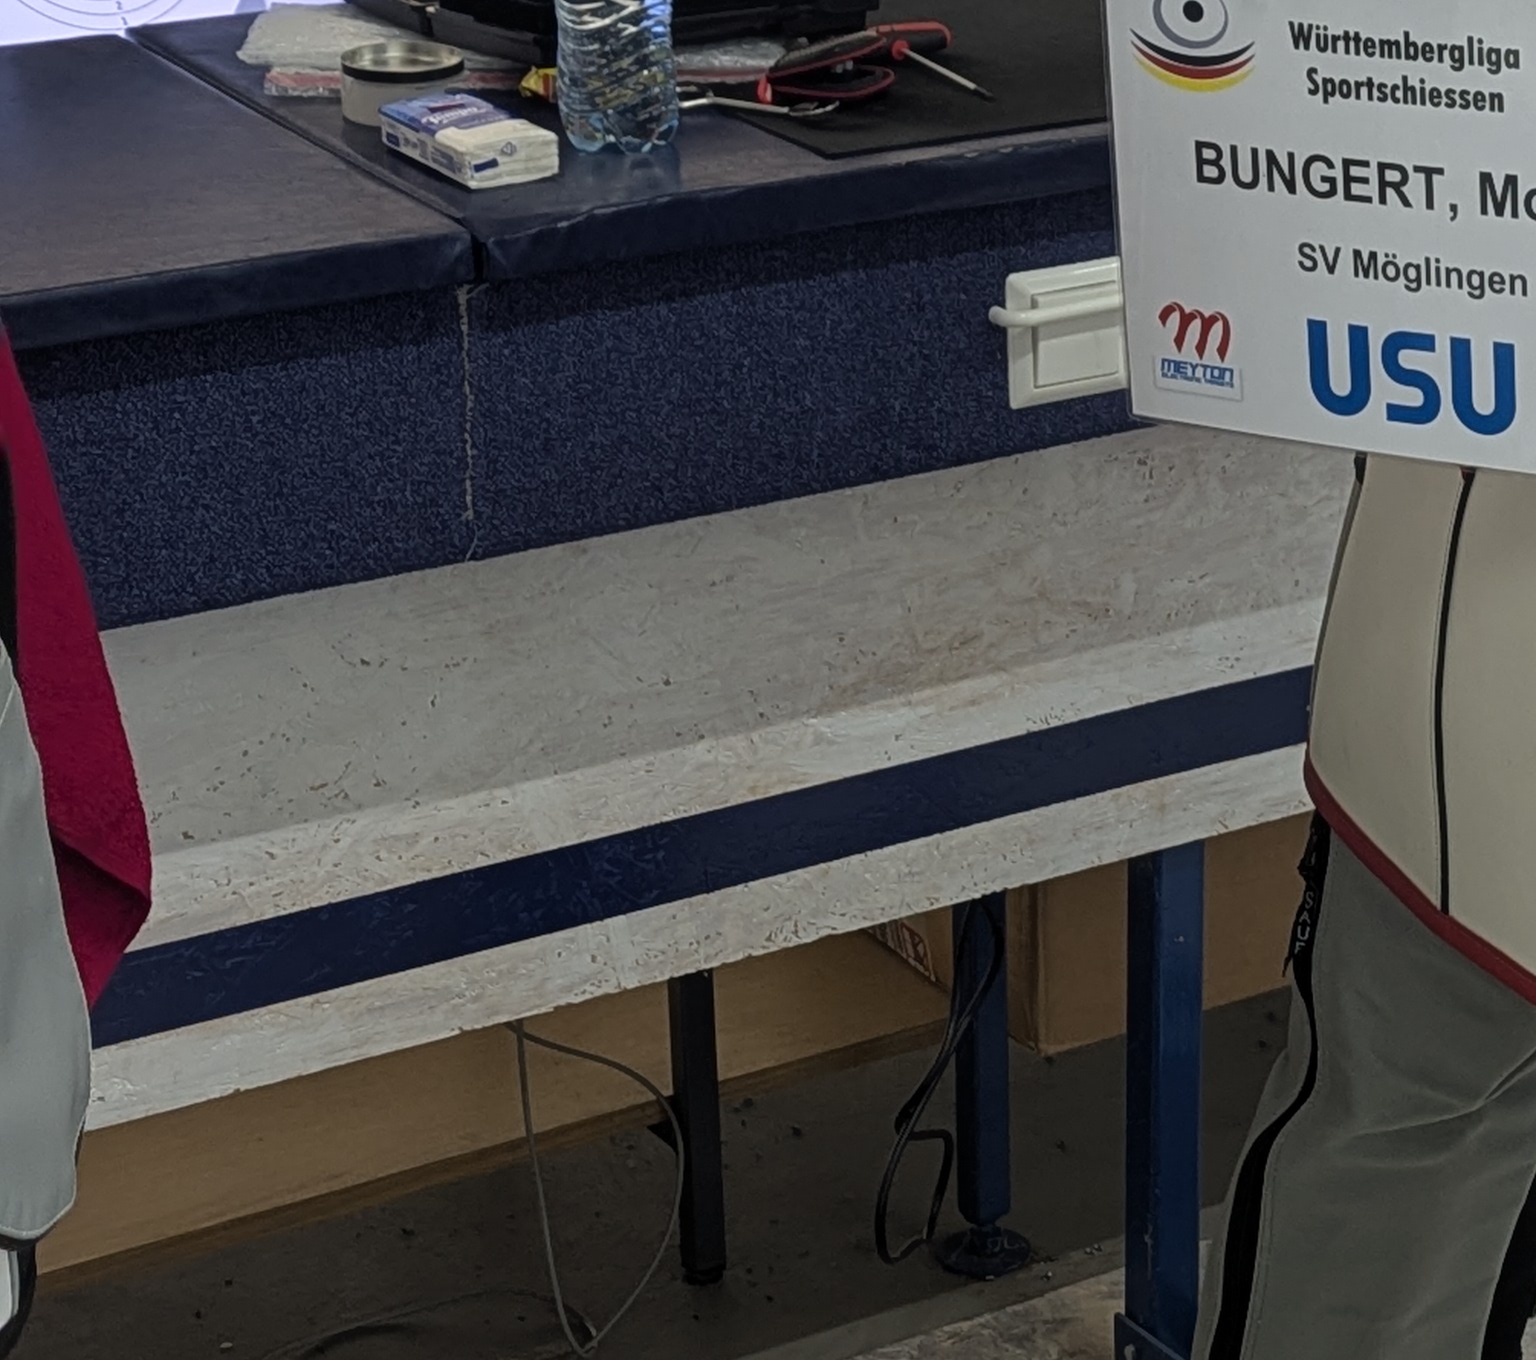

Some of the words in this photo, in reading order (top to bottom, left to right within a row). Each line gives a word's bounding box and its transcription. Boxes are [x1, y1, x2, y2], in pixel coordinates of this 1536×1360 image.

[1288, 20, 1521, 75] Württembergliga
[1306, 67, 1505, 113] Sportschiessen
[1194, 140, 1459, 222] BUNGERT,
[1298, 242, 1342, 275] SV
[1352, 248, 1528, 300] Möglingen
[1161, 358, 1234, 384] MEYTON
[1307, 317, 1517, 436] USU
